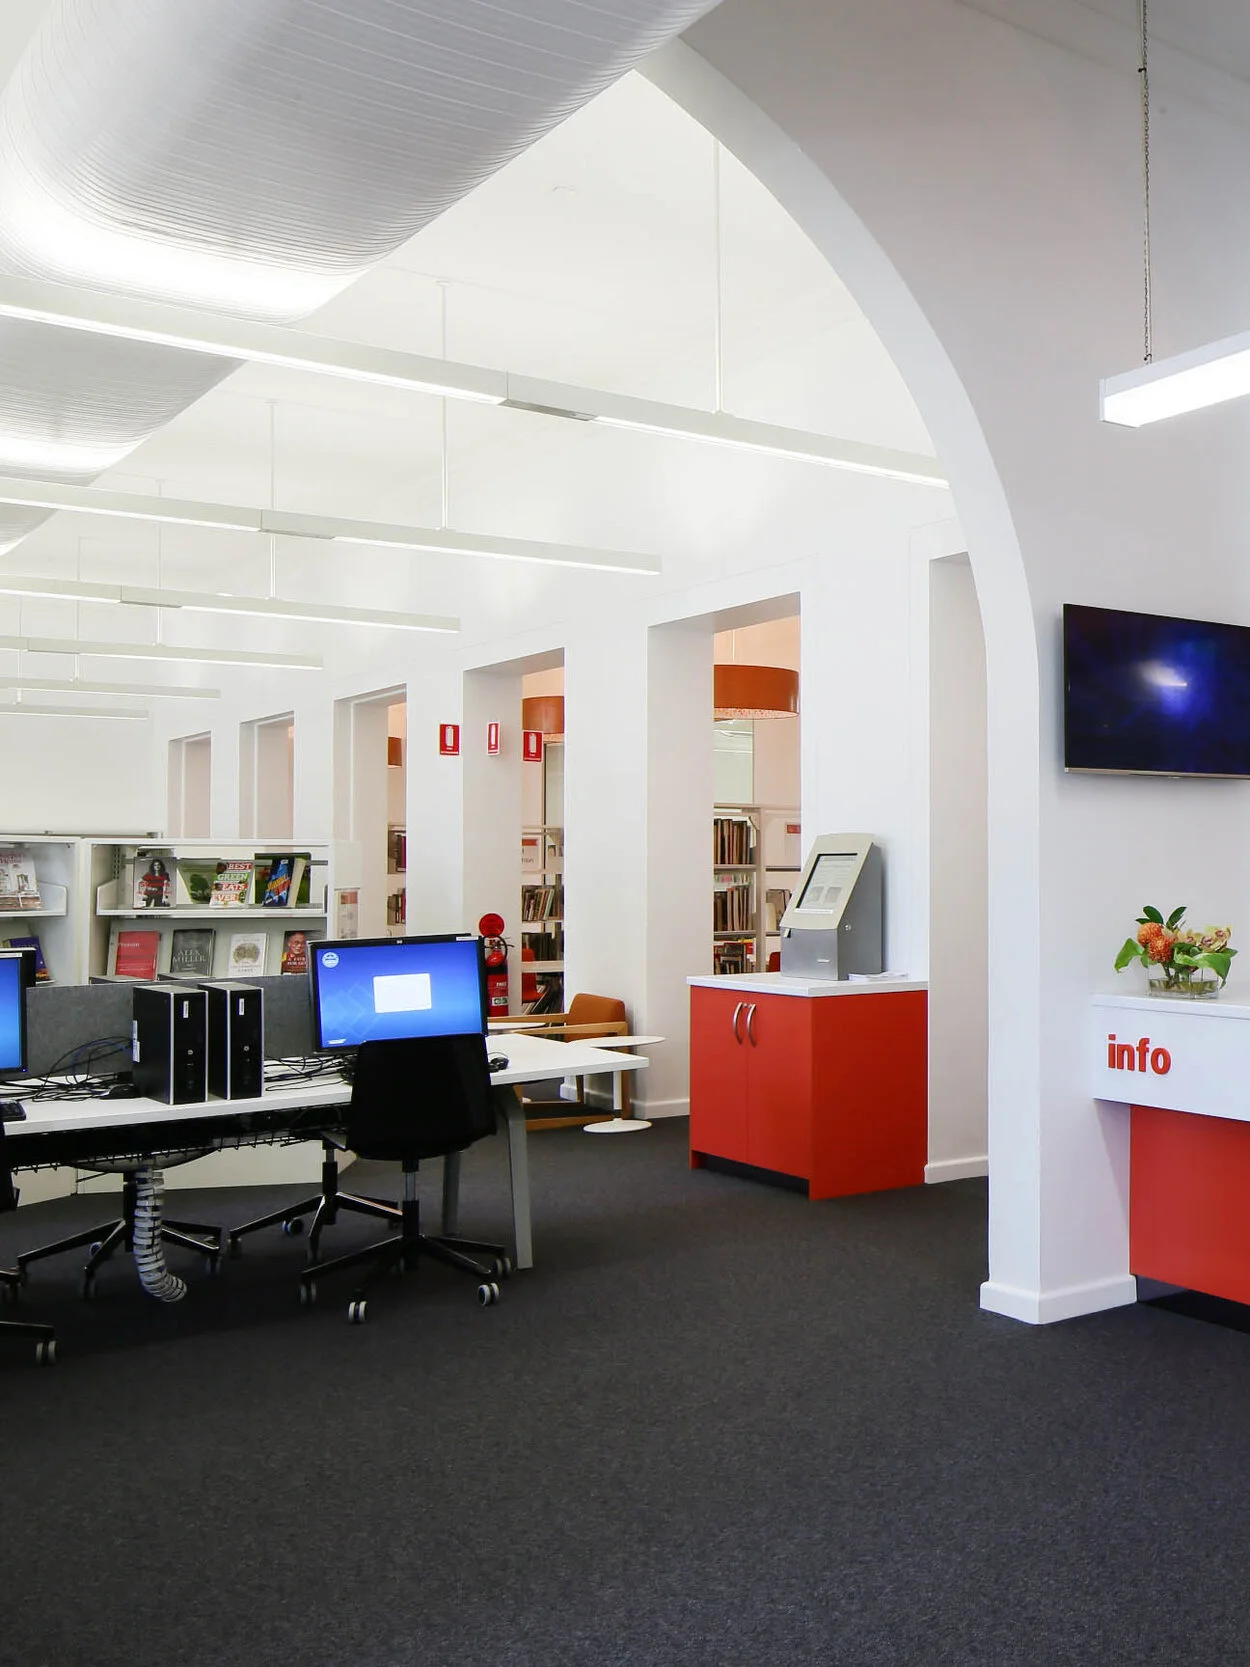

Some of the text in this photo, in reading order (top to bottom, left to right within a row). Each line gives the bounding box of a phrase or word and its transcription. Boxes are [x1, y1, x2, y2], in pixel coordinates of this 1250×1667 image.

[228, 862, 252, 870] BEST
[217, 873, 248, 881] GREEN
[221, 883, 246, 891] EATS
[212, 893, 239, 902] EVER
[1107, 1033, 1172, 1075] info
